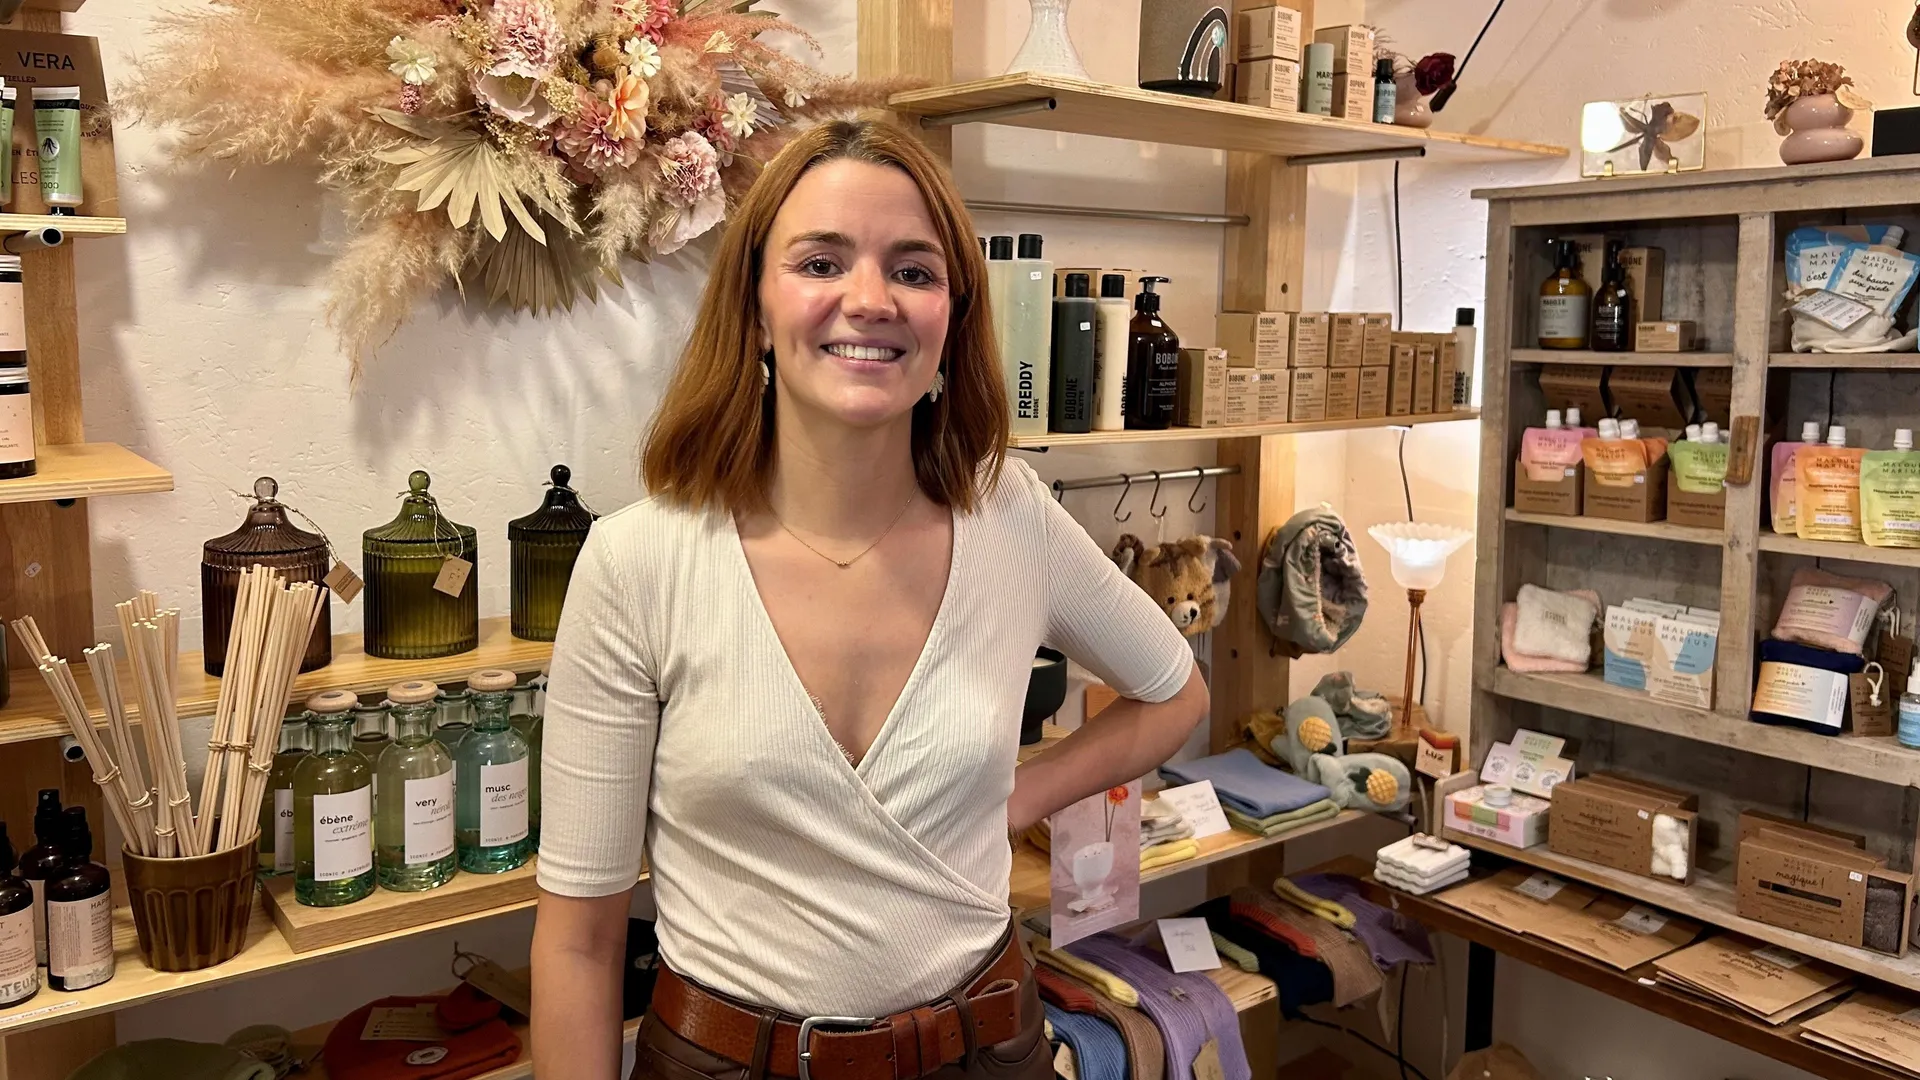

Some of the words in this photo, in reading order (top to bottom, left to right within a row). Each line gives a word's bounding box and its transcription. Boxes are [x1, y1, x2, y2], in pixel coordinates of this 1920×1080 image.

[17, 51, 75, 70] VERA
[4, 75, 36, 83] TIELLES
[1861, 260, 1898, 273] MARIUS
[1806, 271, 1828, 281] c'est
[1866, 272, 1895, 286] baume
[1849, 278, 1866, 288] aux
[1018, 361, 1033, 418] FREDDY
[1064, 378, 1078, 420] BOBONE
[1611, 623, 1652, 635] MARIUS
[1661, 633, 1708, 647] MARIUS
[1425, 749, 1444, 761] LUZ
[485, 784, 511, 792] musc
[415, 798, 437, 807] very
[491, 793, 507, 802] des
[320, 814, 353, 825] ébène
[1775, 871, 1819, 888] magique
[1821, 877, 1825, 888] !
